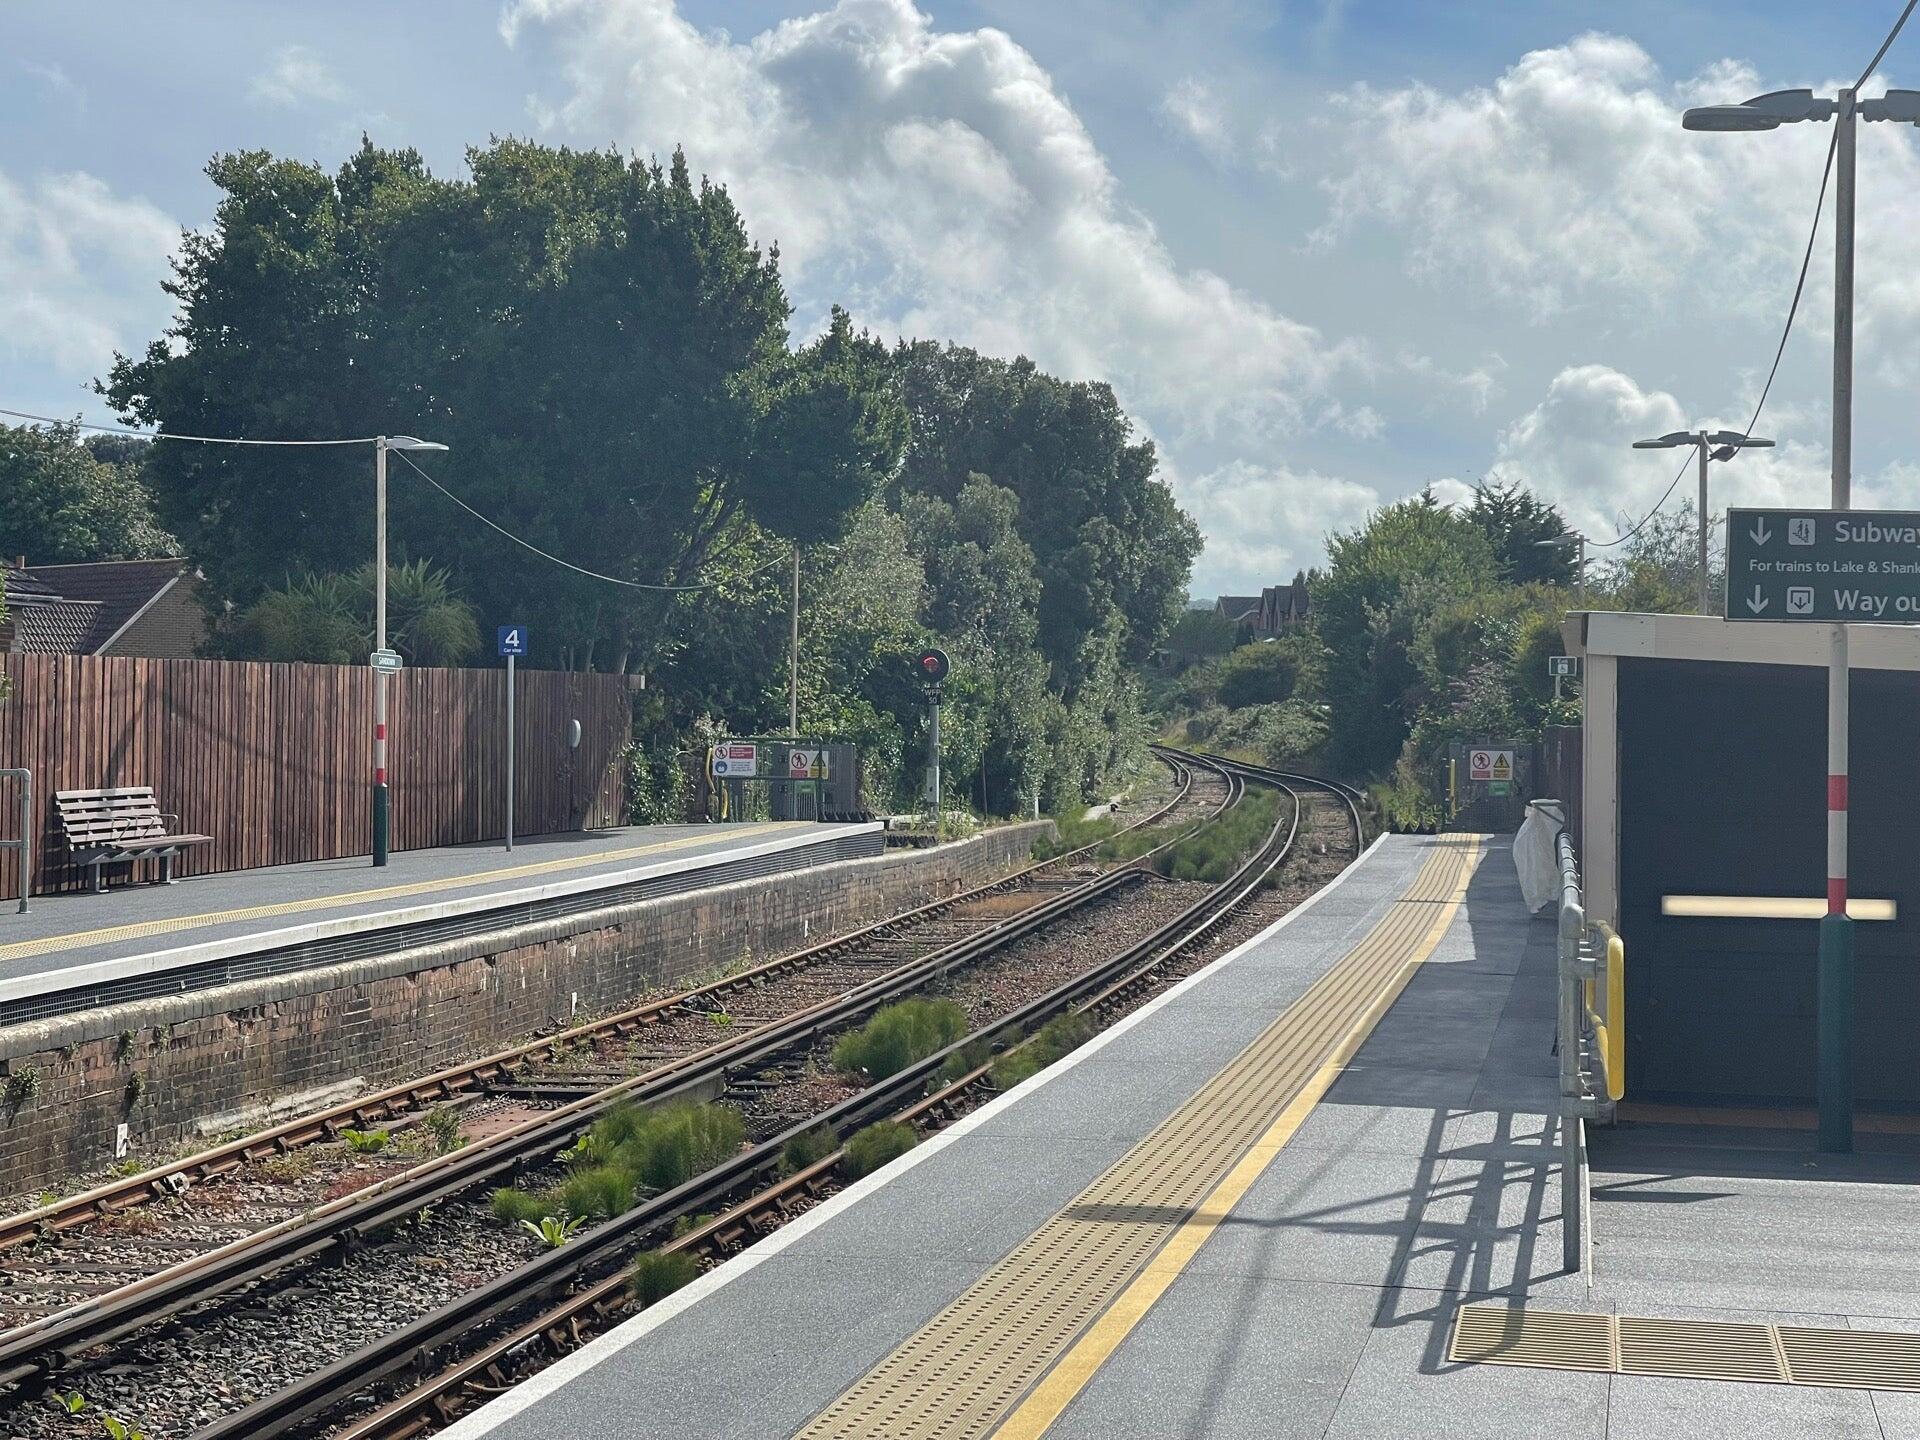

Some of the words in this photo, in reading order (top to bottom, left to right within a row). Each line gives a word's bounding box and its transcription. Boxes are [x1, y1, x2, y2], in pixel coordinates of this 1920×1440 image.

[1750, 560, 1772, 572] For
[1776, 560, 1812, 572] trains
[1816, 561, 1830, 573] to
[1833, 561, 1864, 573] Lake
[1867, 561, 1878, 573] &
[1834, 589, 1889, 617] Way
[505, 629, 520, 647] 4
